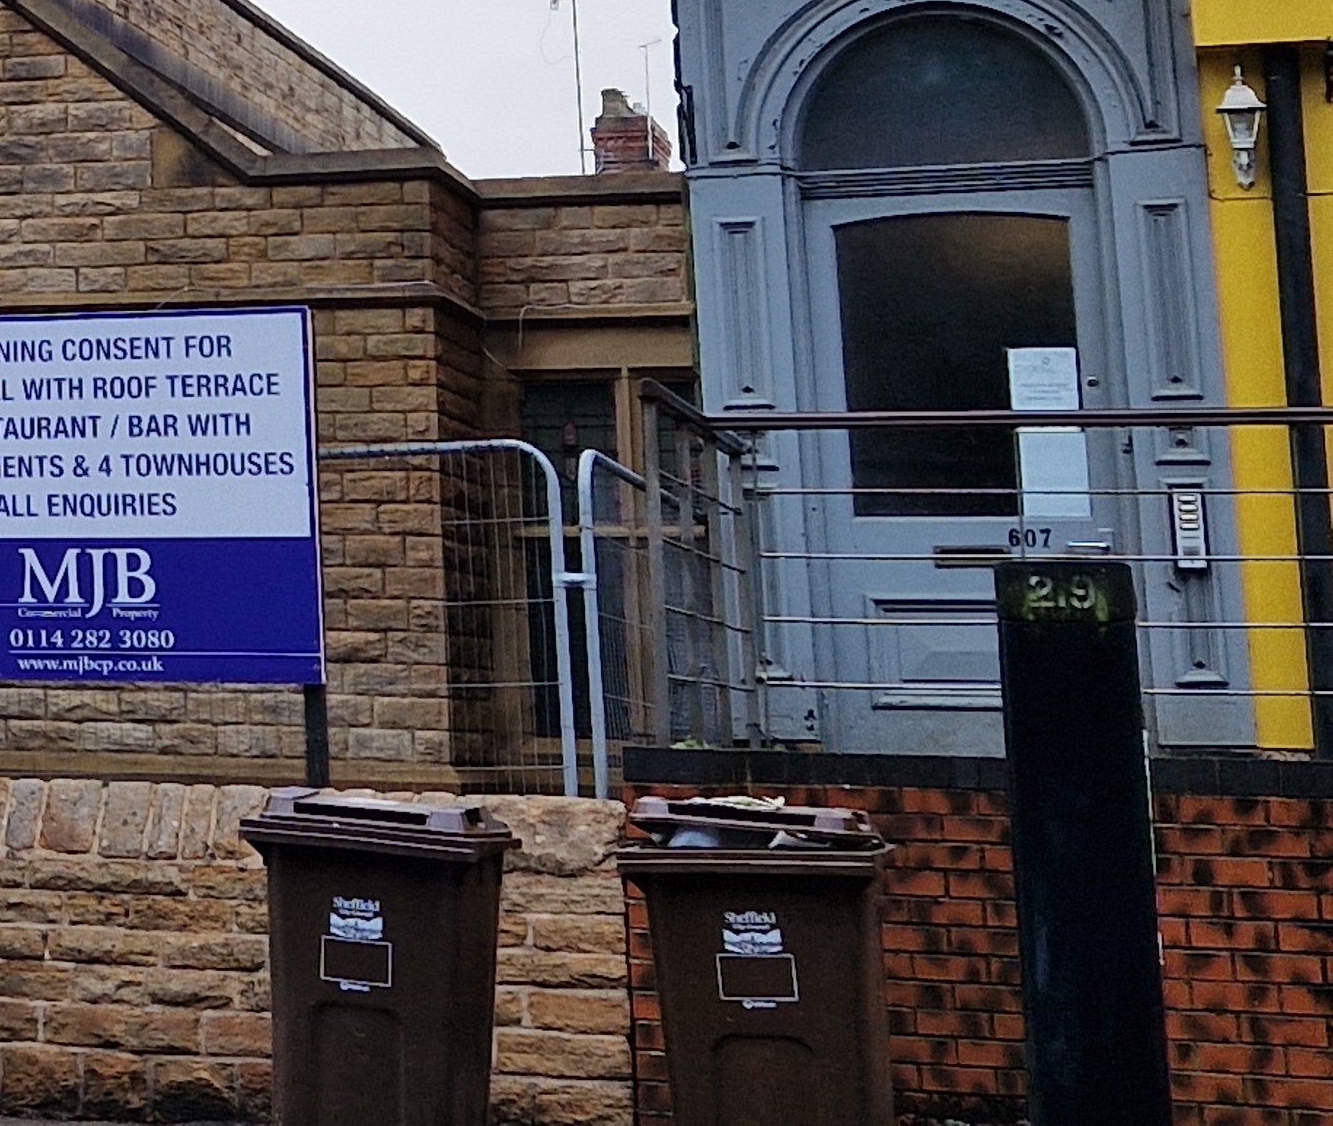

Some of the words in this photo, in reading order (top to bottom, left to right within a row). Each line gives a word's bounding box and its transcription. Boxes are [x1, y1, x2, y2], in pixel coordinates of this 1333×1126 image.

[61, 336, 175, 362] CONSENT
[184, 335, 232, 359] FOR
[21, 376, 84, 401] WITH
[92, 376, 158, 400] ROOF
[165, 372, 281, 398] TERRACE
[110, 414, 120, 439] /
[128, 414, 179, 439] BAR
[187, 412, 252, 437] WITH
[72, 454, 91, 478] &
[98, 454, 113, 477] 4
[120, 451, 295, 477] TOWNHOUSES
[46, 492, 178, 519] ENQUIRIES
[1008, 527, 1052, 549] 607
[17, 547, 157, 619] MJB
[17, 607, 82, 618] Coercial
[111, 607, 160, 621] Property
[9, 628, 64, 648] 0114
[70, 629, 112, 648] 282
[118, 629, 176, 649] 3080
[17, 655, 165, 676] www.mjbcp.co.uk
